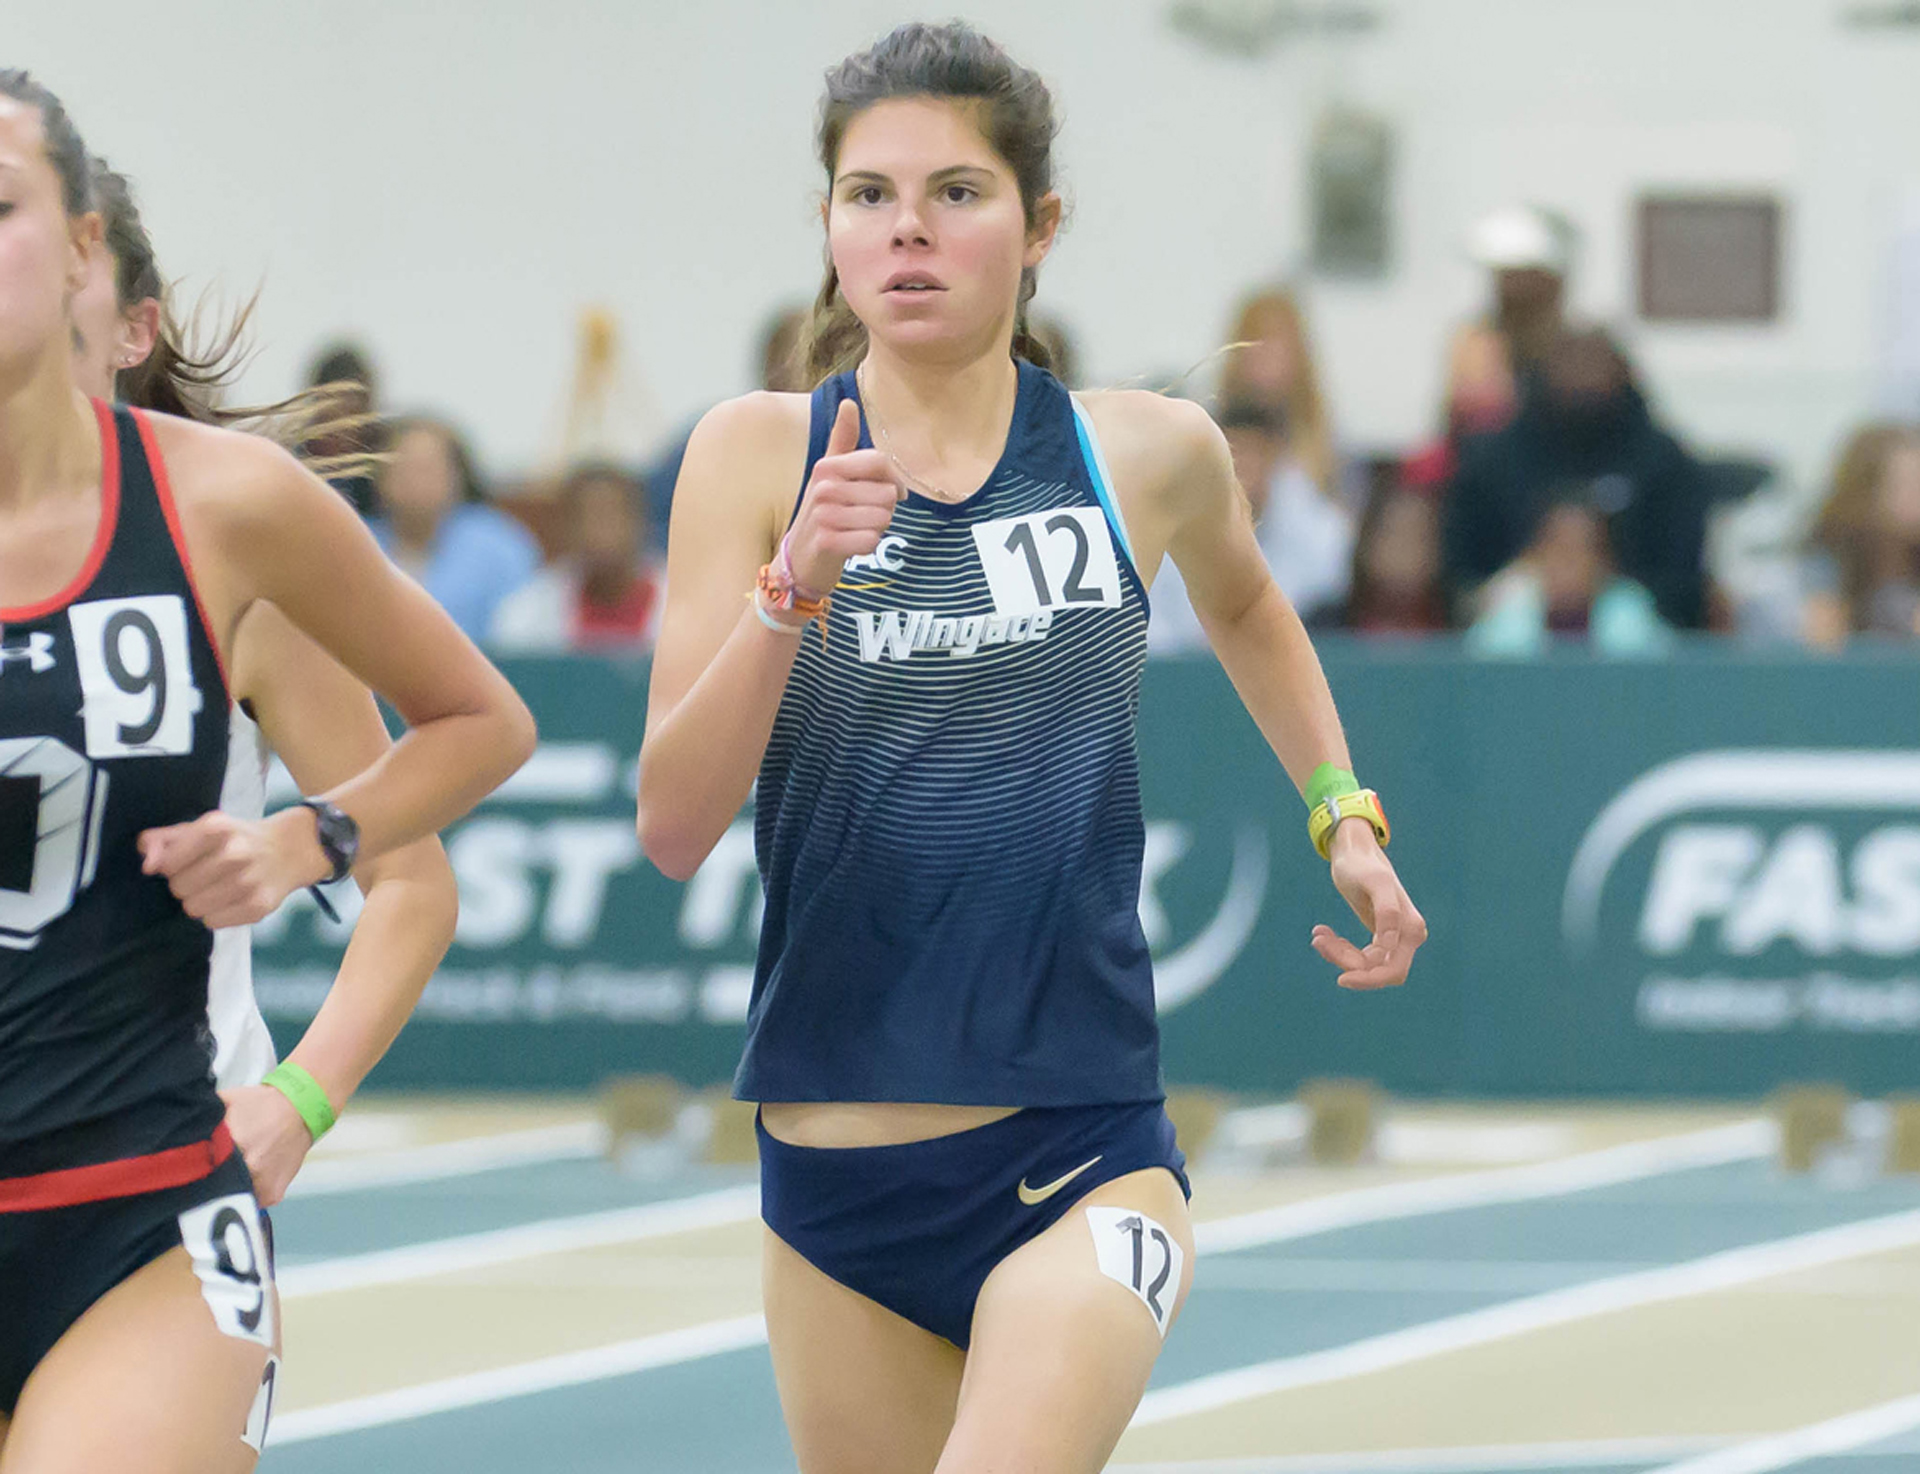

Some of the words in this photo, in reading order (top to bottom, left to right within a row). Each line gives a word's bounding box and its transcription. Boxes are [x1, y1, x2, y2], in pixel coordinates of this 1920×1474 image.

[1003, 514, 1104, 606] 12
[104, 608, 166, 744] 9
[1115, 1216, 1171, 1323] 12
